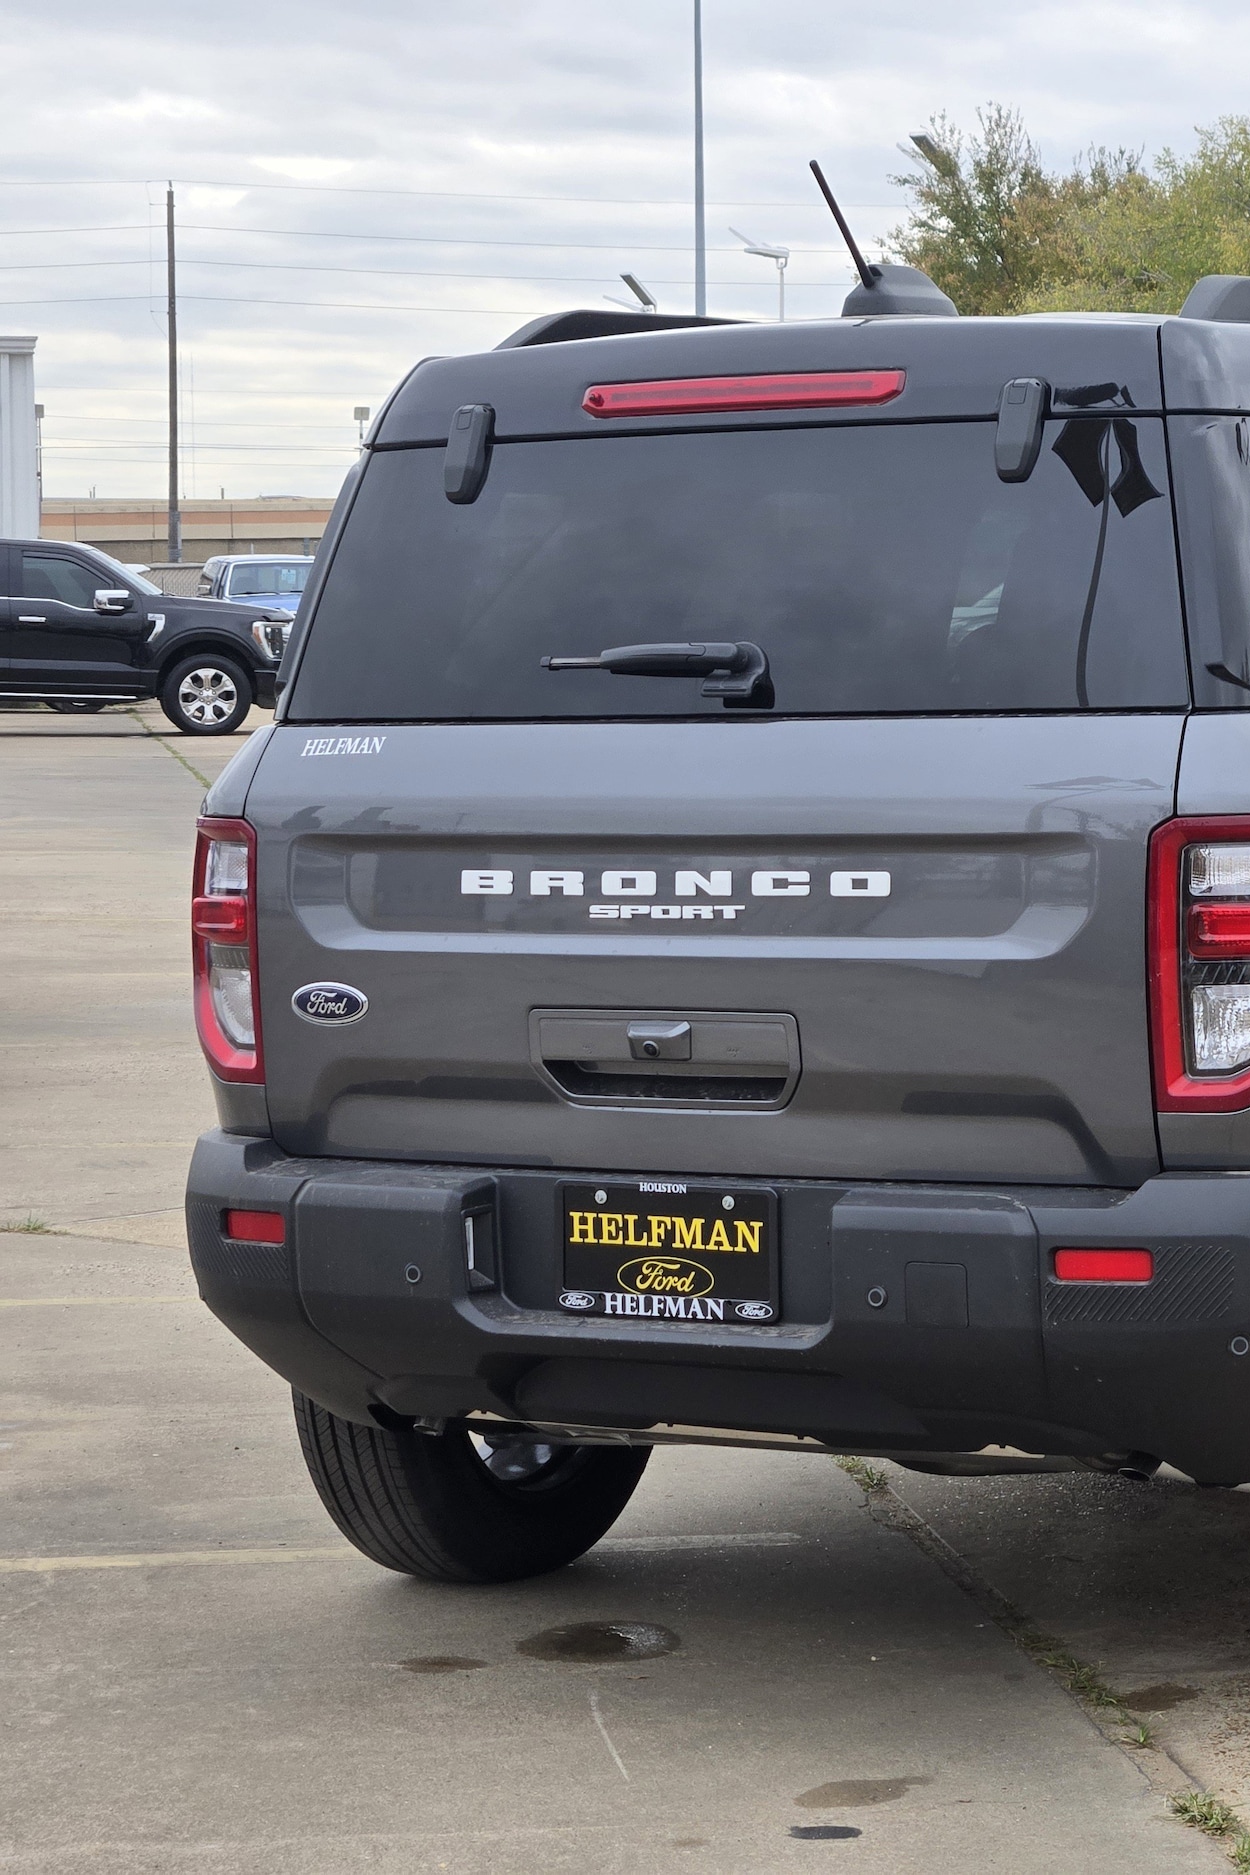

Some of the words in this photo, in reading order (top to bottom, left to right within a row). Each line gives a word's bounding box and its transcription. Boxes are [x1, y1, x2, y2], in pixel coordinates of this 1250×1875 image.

[300, 736, 388, 757] HELFMAN
[460, 869, 892, 897] BRONCO
[588, 904, 746, 920] SPORT
[306, 990, 348, 1015] Ford
[639, 1182, 687, 1194] HOUSTON
[568, 1211, 764, 1254] HELFMAN
[635, 1260, 696, 1294] Ford
[604, 1293, 724, 1320] HELFMAN
